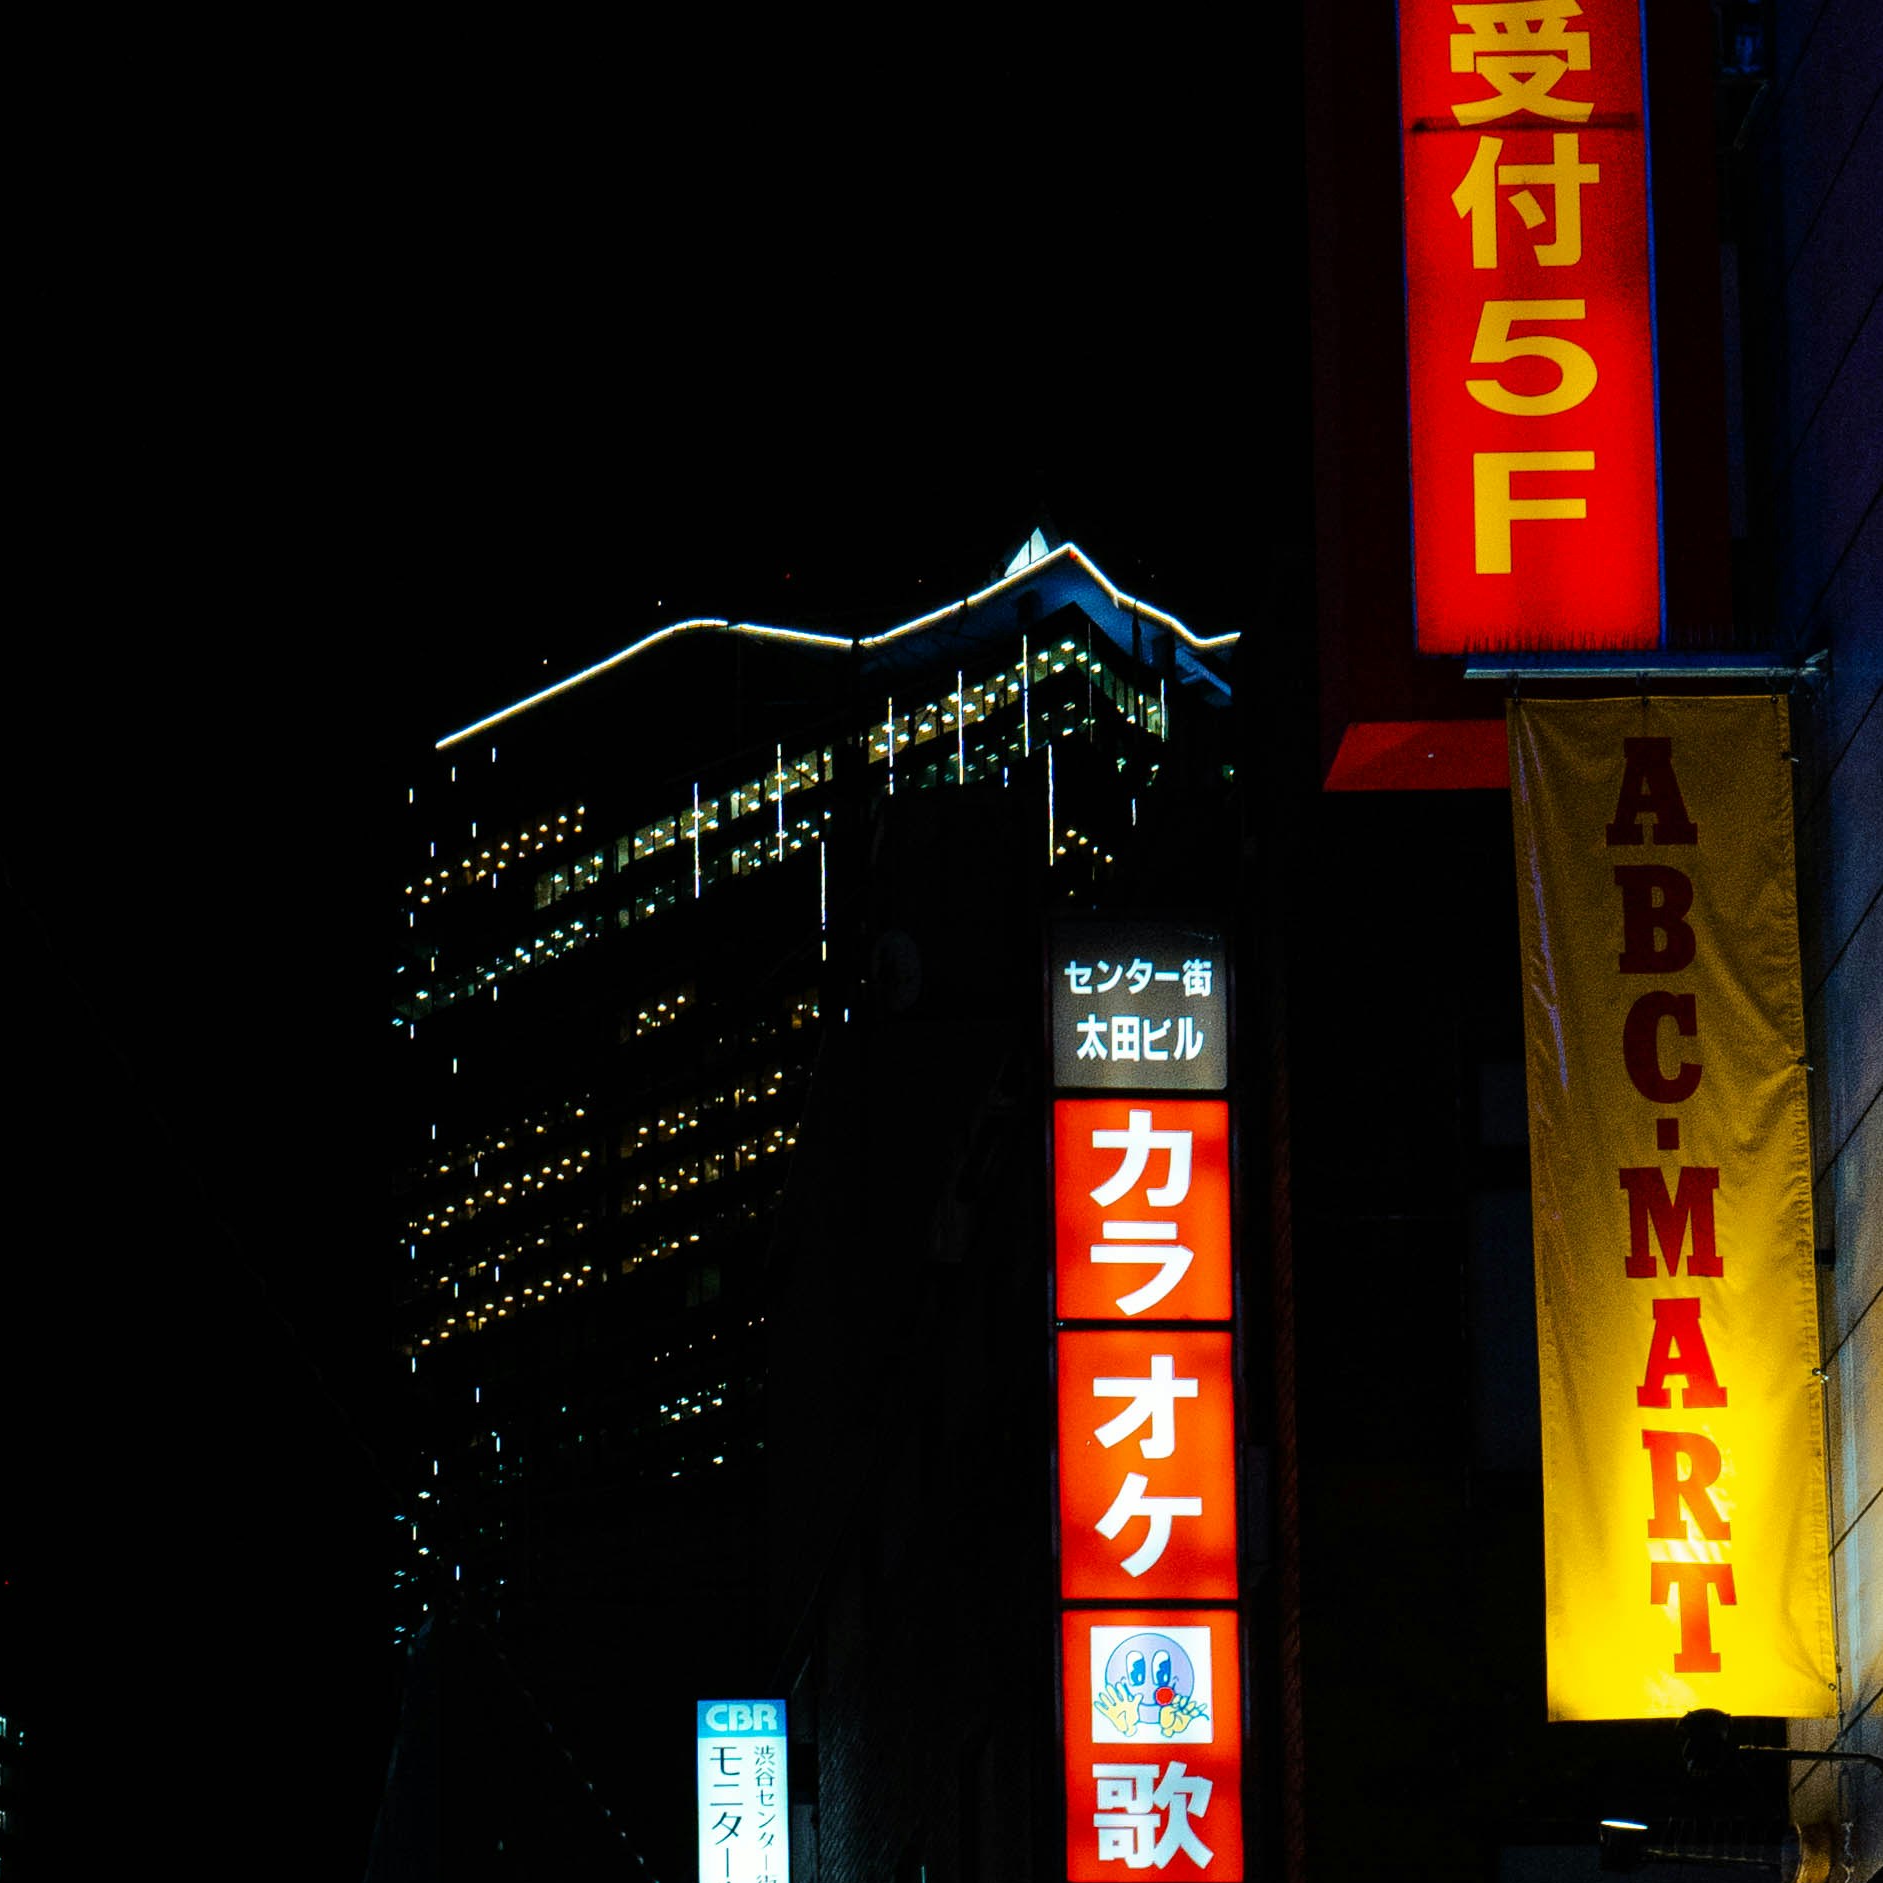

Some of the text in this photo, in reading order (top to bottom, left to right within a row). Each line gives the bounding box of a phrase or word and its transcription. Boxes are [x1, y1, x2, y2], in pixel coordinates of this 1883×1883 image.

[1064, 958, 1213, 998] センター街
[1076, 1014, 1204, 1062] 太田ビル
[1605, 735, 1740, 1675] ABC-MART
[706, 1704, 777, 1732] CBR
